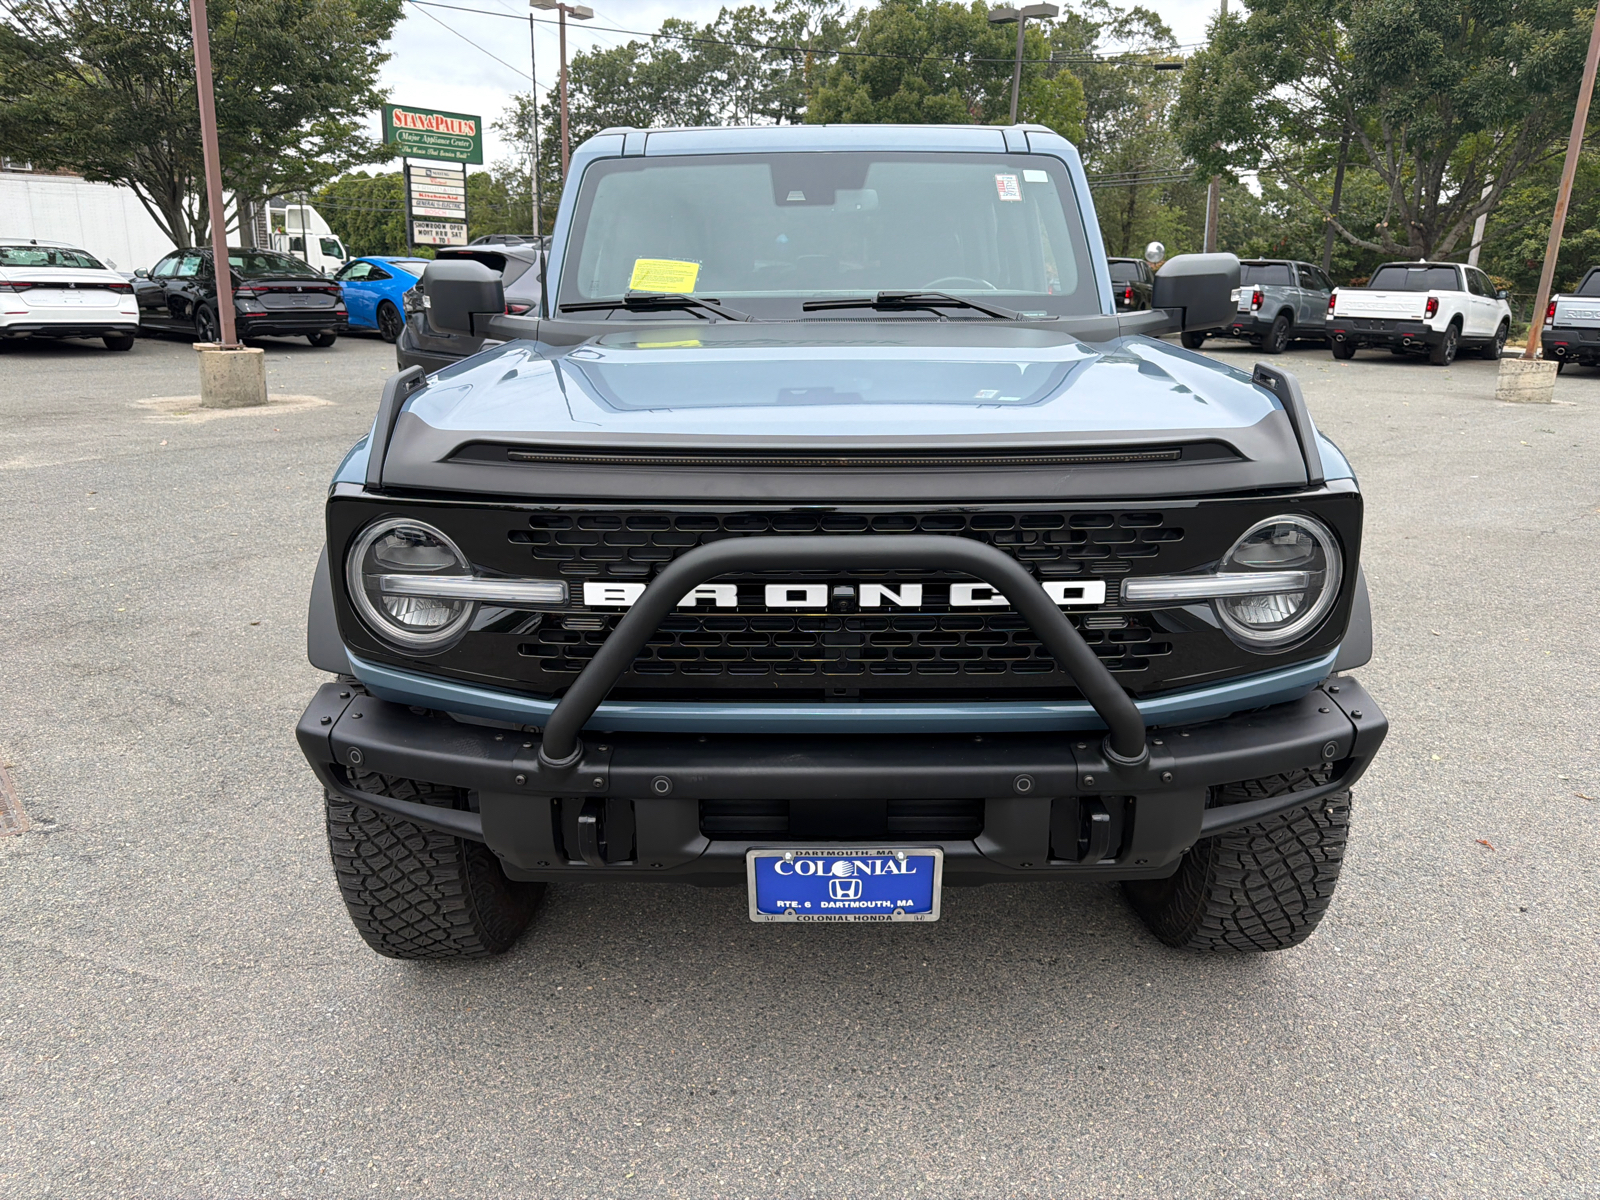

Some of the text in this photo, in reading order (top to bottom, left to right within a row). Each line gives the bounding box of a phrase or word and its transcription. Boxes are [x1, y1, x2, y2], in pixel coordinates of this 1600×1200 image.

[402, 132, 470, 147] Major Appliance Center
[583, 580, 1106, 607] BRONCO
[774, 859, 917, 877] COLONIAL
[820, 900, 894, 908] DARTMOUTH,
